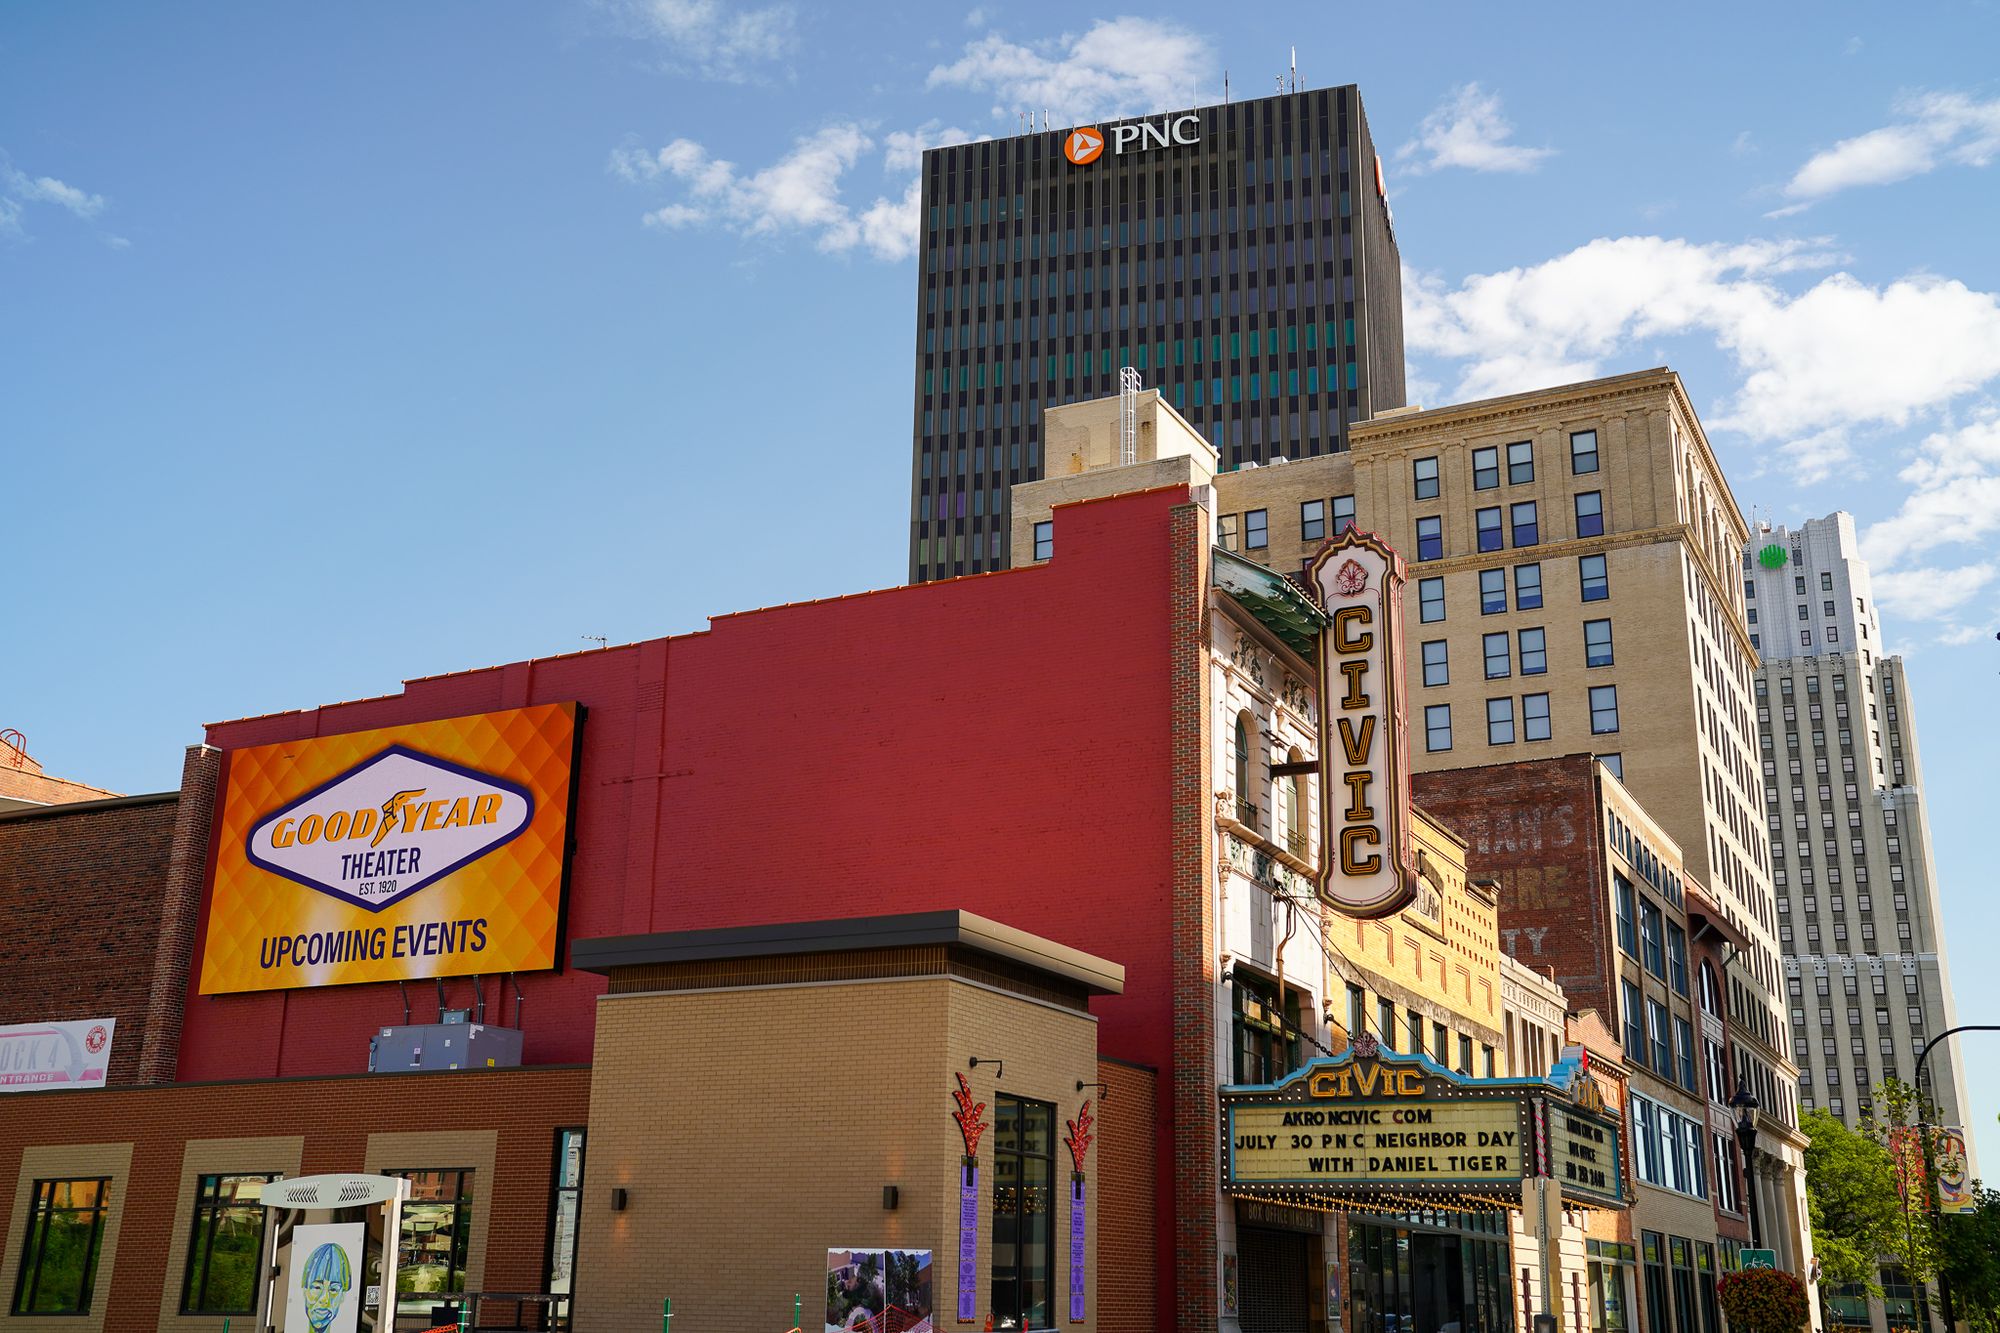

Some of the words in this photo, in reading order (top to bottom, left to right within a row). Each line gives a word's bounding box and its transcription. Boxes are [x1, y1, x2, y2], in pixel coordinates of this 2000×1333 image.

[1111, 115, 1201, 155] PNC
[1333, 605, 1382, 877] CIVIC
[341, 847, 421, 881] THEATER
[358, 882, 377, 896] EST.
[378, 879, 397, 894] 1920
[260, 927, 386, 969] UPCOMING
[391, 918, 488, 959] EVENTS
[1309, 1062, 1425, 1097] CIVIC
[1392, 1109, 1433, 1124] COM
[1235, 1135, 1277, 1150] JULY
[1291, 1134, 1313, 1149] 30
[1375, 1132, 1467, 1148] NEIGHBOR
[1477, 1131, 1515, 1147] DAY
[1308, 1157, 1353, 1172] WITH
[1368, 1157, 1438, 1172] DANIEL
[1448, 1156, 1508, 1171] TIGER
[1248, 1203, 1263, 1219] BOX
[1265, 1206, 1287, 1224] OFFICE
